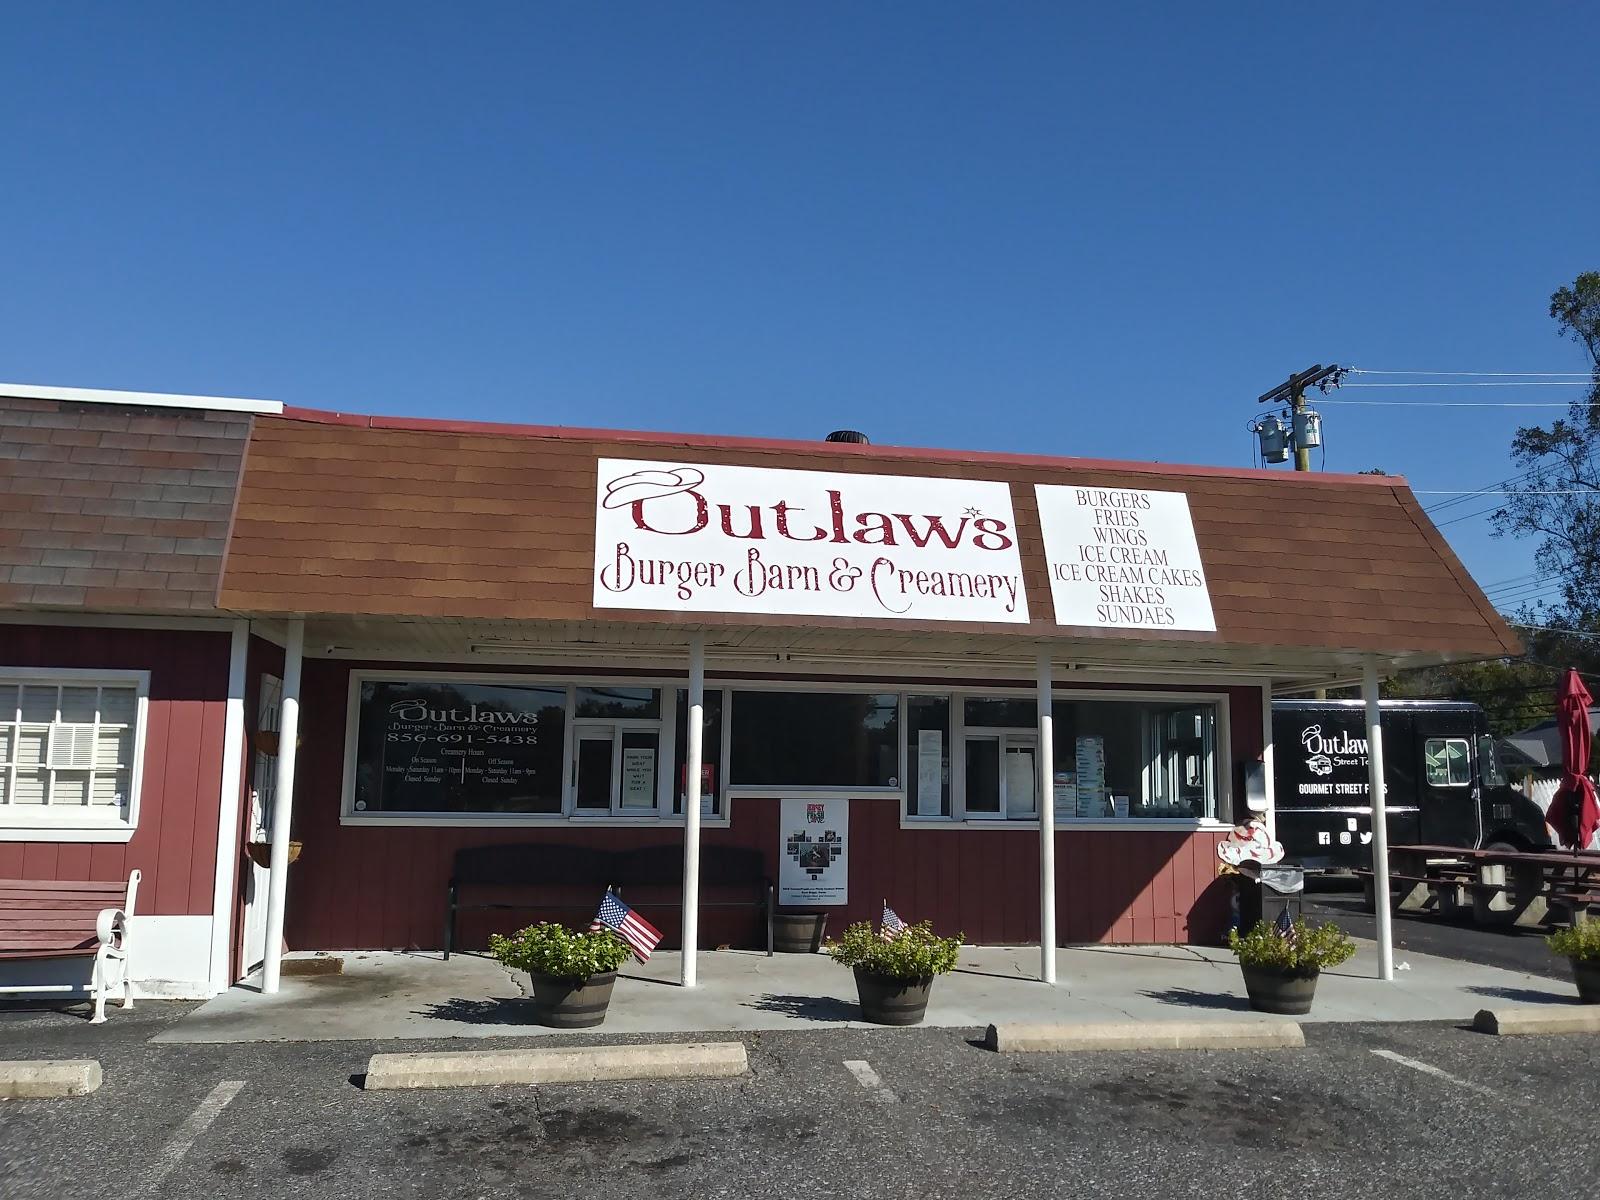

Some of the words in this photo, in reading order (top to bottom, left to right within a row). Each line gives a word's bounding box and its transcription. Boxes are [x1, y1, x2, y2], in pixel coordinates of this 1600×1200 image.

[1075, 489, 1151, 510] BURGERS
[1094, 508, 1139, 527] FRIES
[1092, 527, 1148, 546] WINGS
[1078, 545, 1107, 563] ICE
[1110, 546, 1169, 566] CREAM
[600, 541, 725, 600] Burger
[734, 547, 820, 597] Barn
[828, 557, 862, 592] &
[871, 556, 1018, 613] Creamery
[1053, 563, 1082, 581] ICE
[1085, 564, 1145, 584] CREAM
[1148, 567, 1202, 587] CAKES
[1099, 584, 1165, 605] SHAKES
[1096, 604, 1175, 625] SUNDAES
[388, 722, 432, 732] Burger
[434, 723, 465, 732] Barn
[483, 724, 538, 734] Creamery
[387, 733, 538, 745] 856-691-5438
[1305, 729, 1369, 754] Outlaw
[440, 748, 466, 757] Creamery
[1332, 756, 1358, 766] Street
[386, 766, 405, 774] Monday
[424, 775, 442, 784] Sunday
[465, 767, 484, 775] Monday
[1298, 783, 1334, 794] GOURMET
[1336, 783, 1362, 794] STREET
